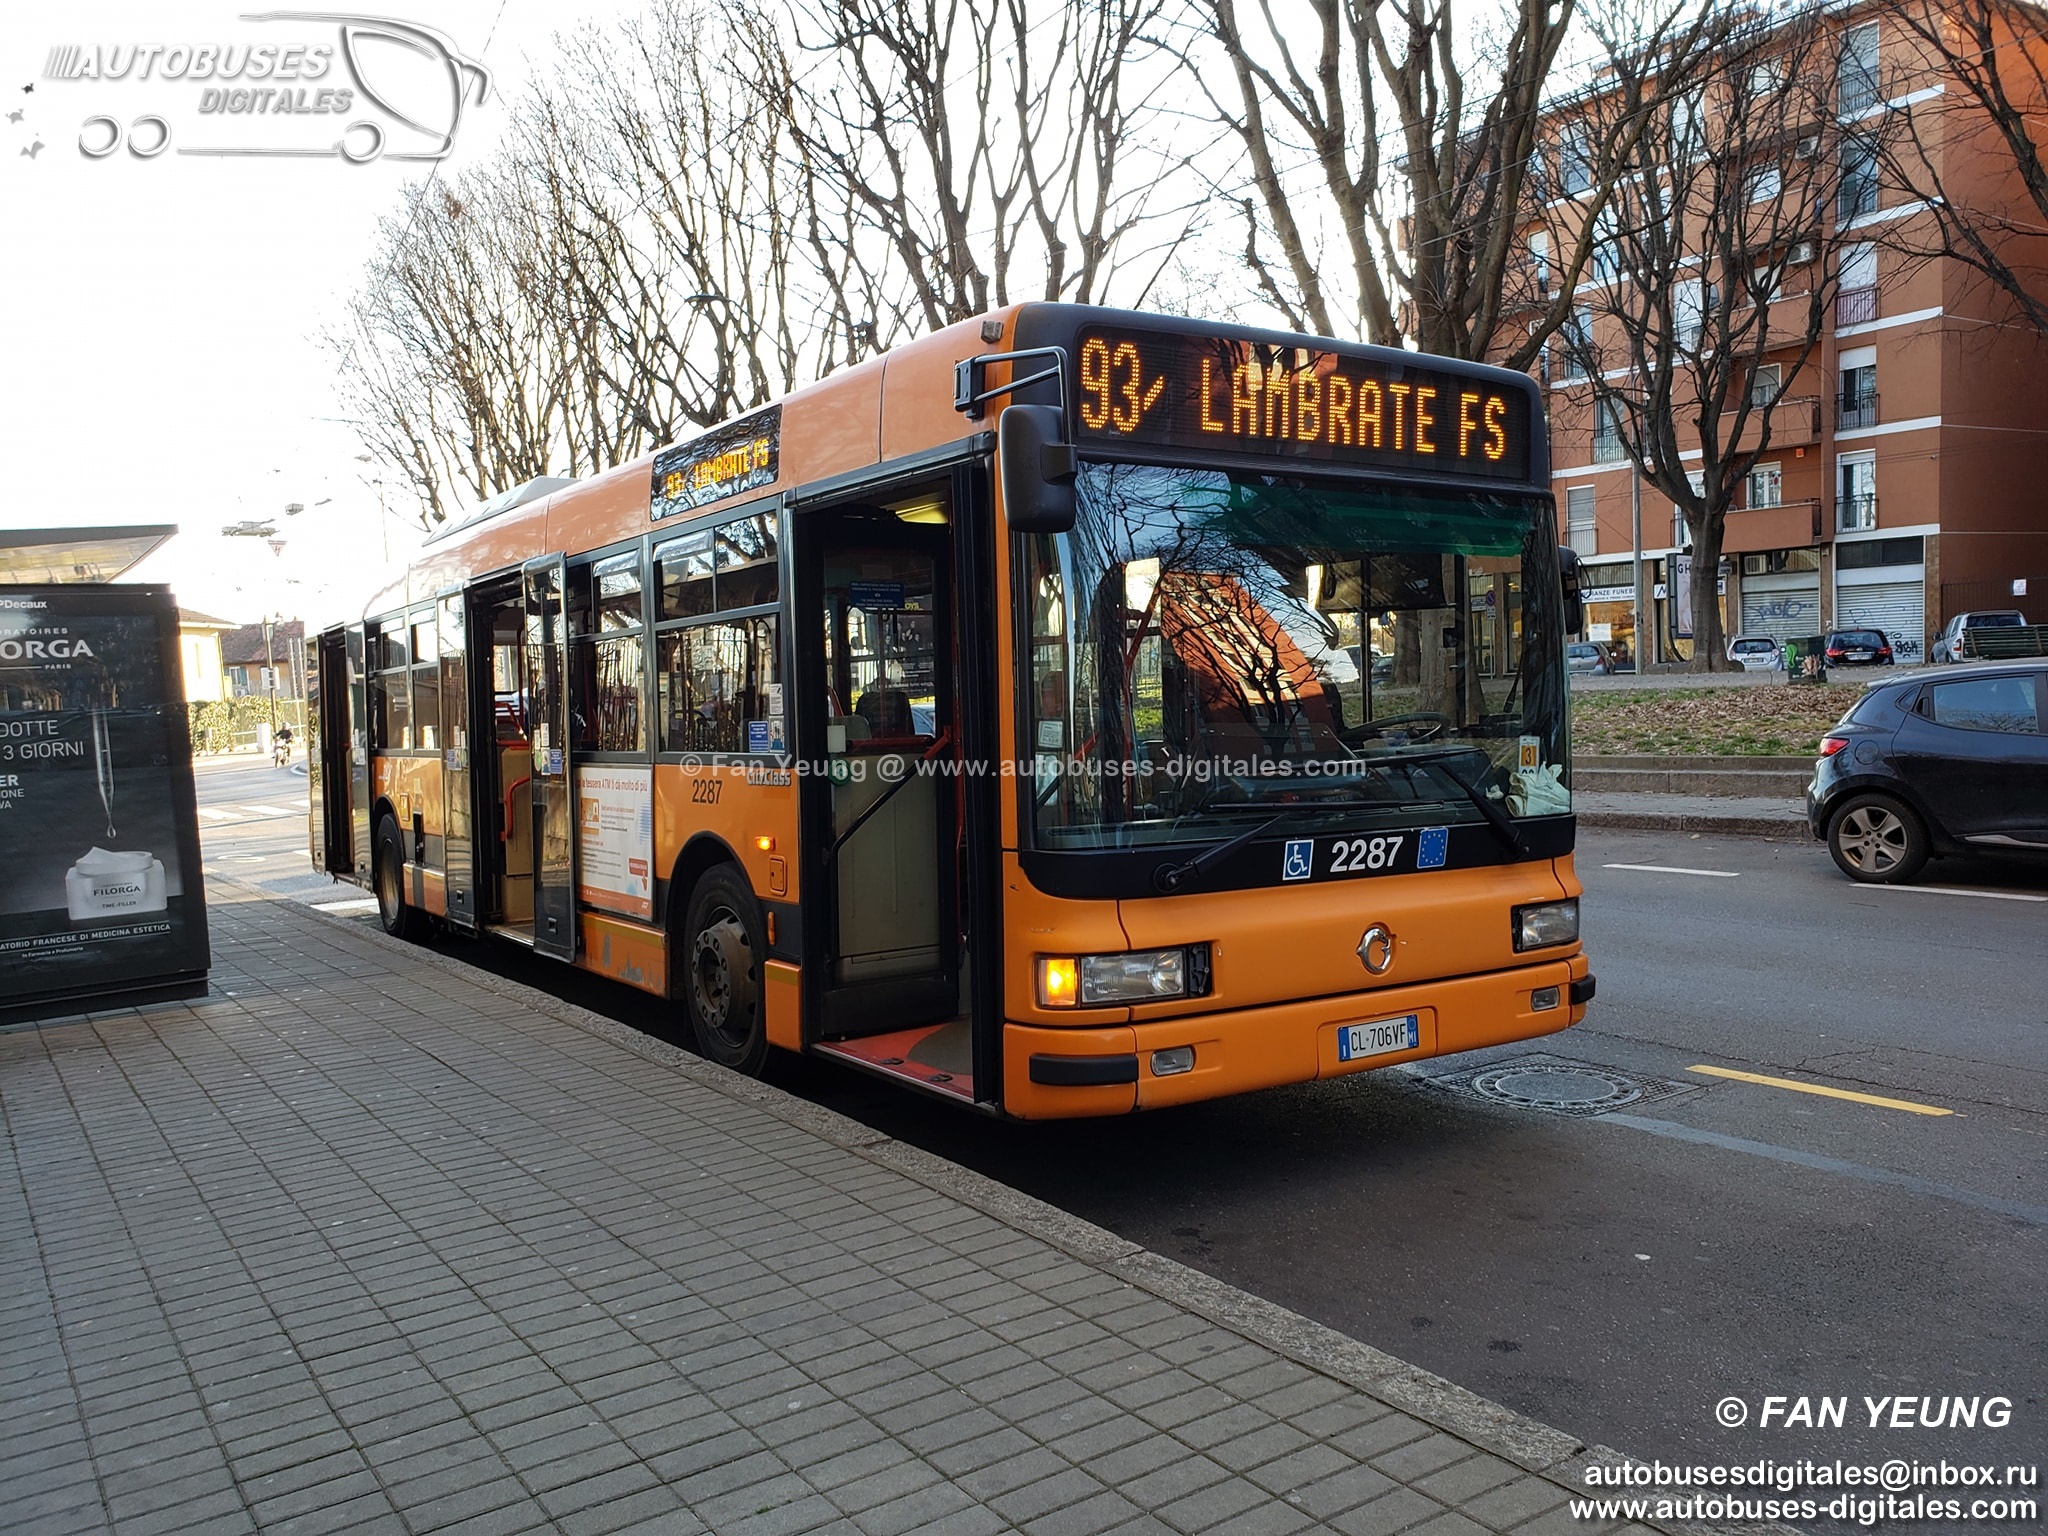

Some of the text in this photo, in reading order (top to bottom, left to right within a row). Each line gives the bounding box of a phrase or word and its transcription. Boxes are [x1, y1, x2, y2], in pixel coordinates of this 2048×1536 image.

[1202, 358, 1436, 453] LAMBRATE
[1459, 392, 1505, 460] FS
[1612, 587, 1635, 596] FUNEB
[3, 741, 84, 760] 3 GIORNI
[692, 779, 723, 804] 2287
[1330, 836, 1403, 872] 2287
[94, 885, 141, 896] FILORGA
[33, 934, 77, 946] FRANCESE
[80, 933, 89, 941] DI
[91, 928, 131, 939] MEDICINA
[133, 924, 171, 934] ESTETICA
[1408, 1031, 1417, 1044] MI
